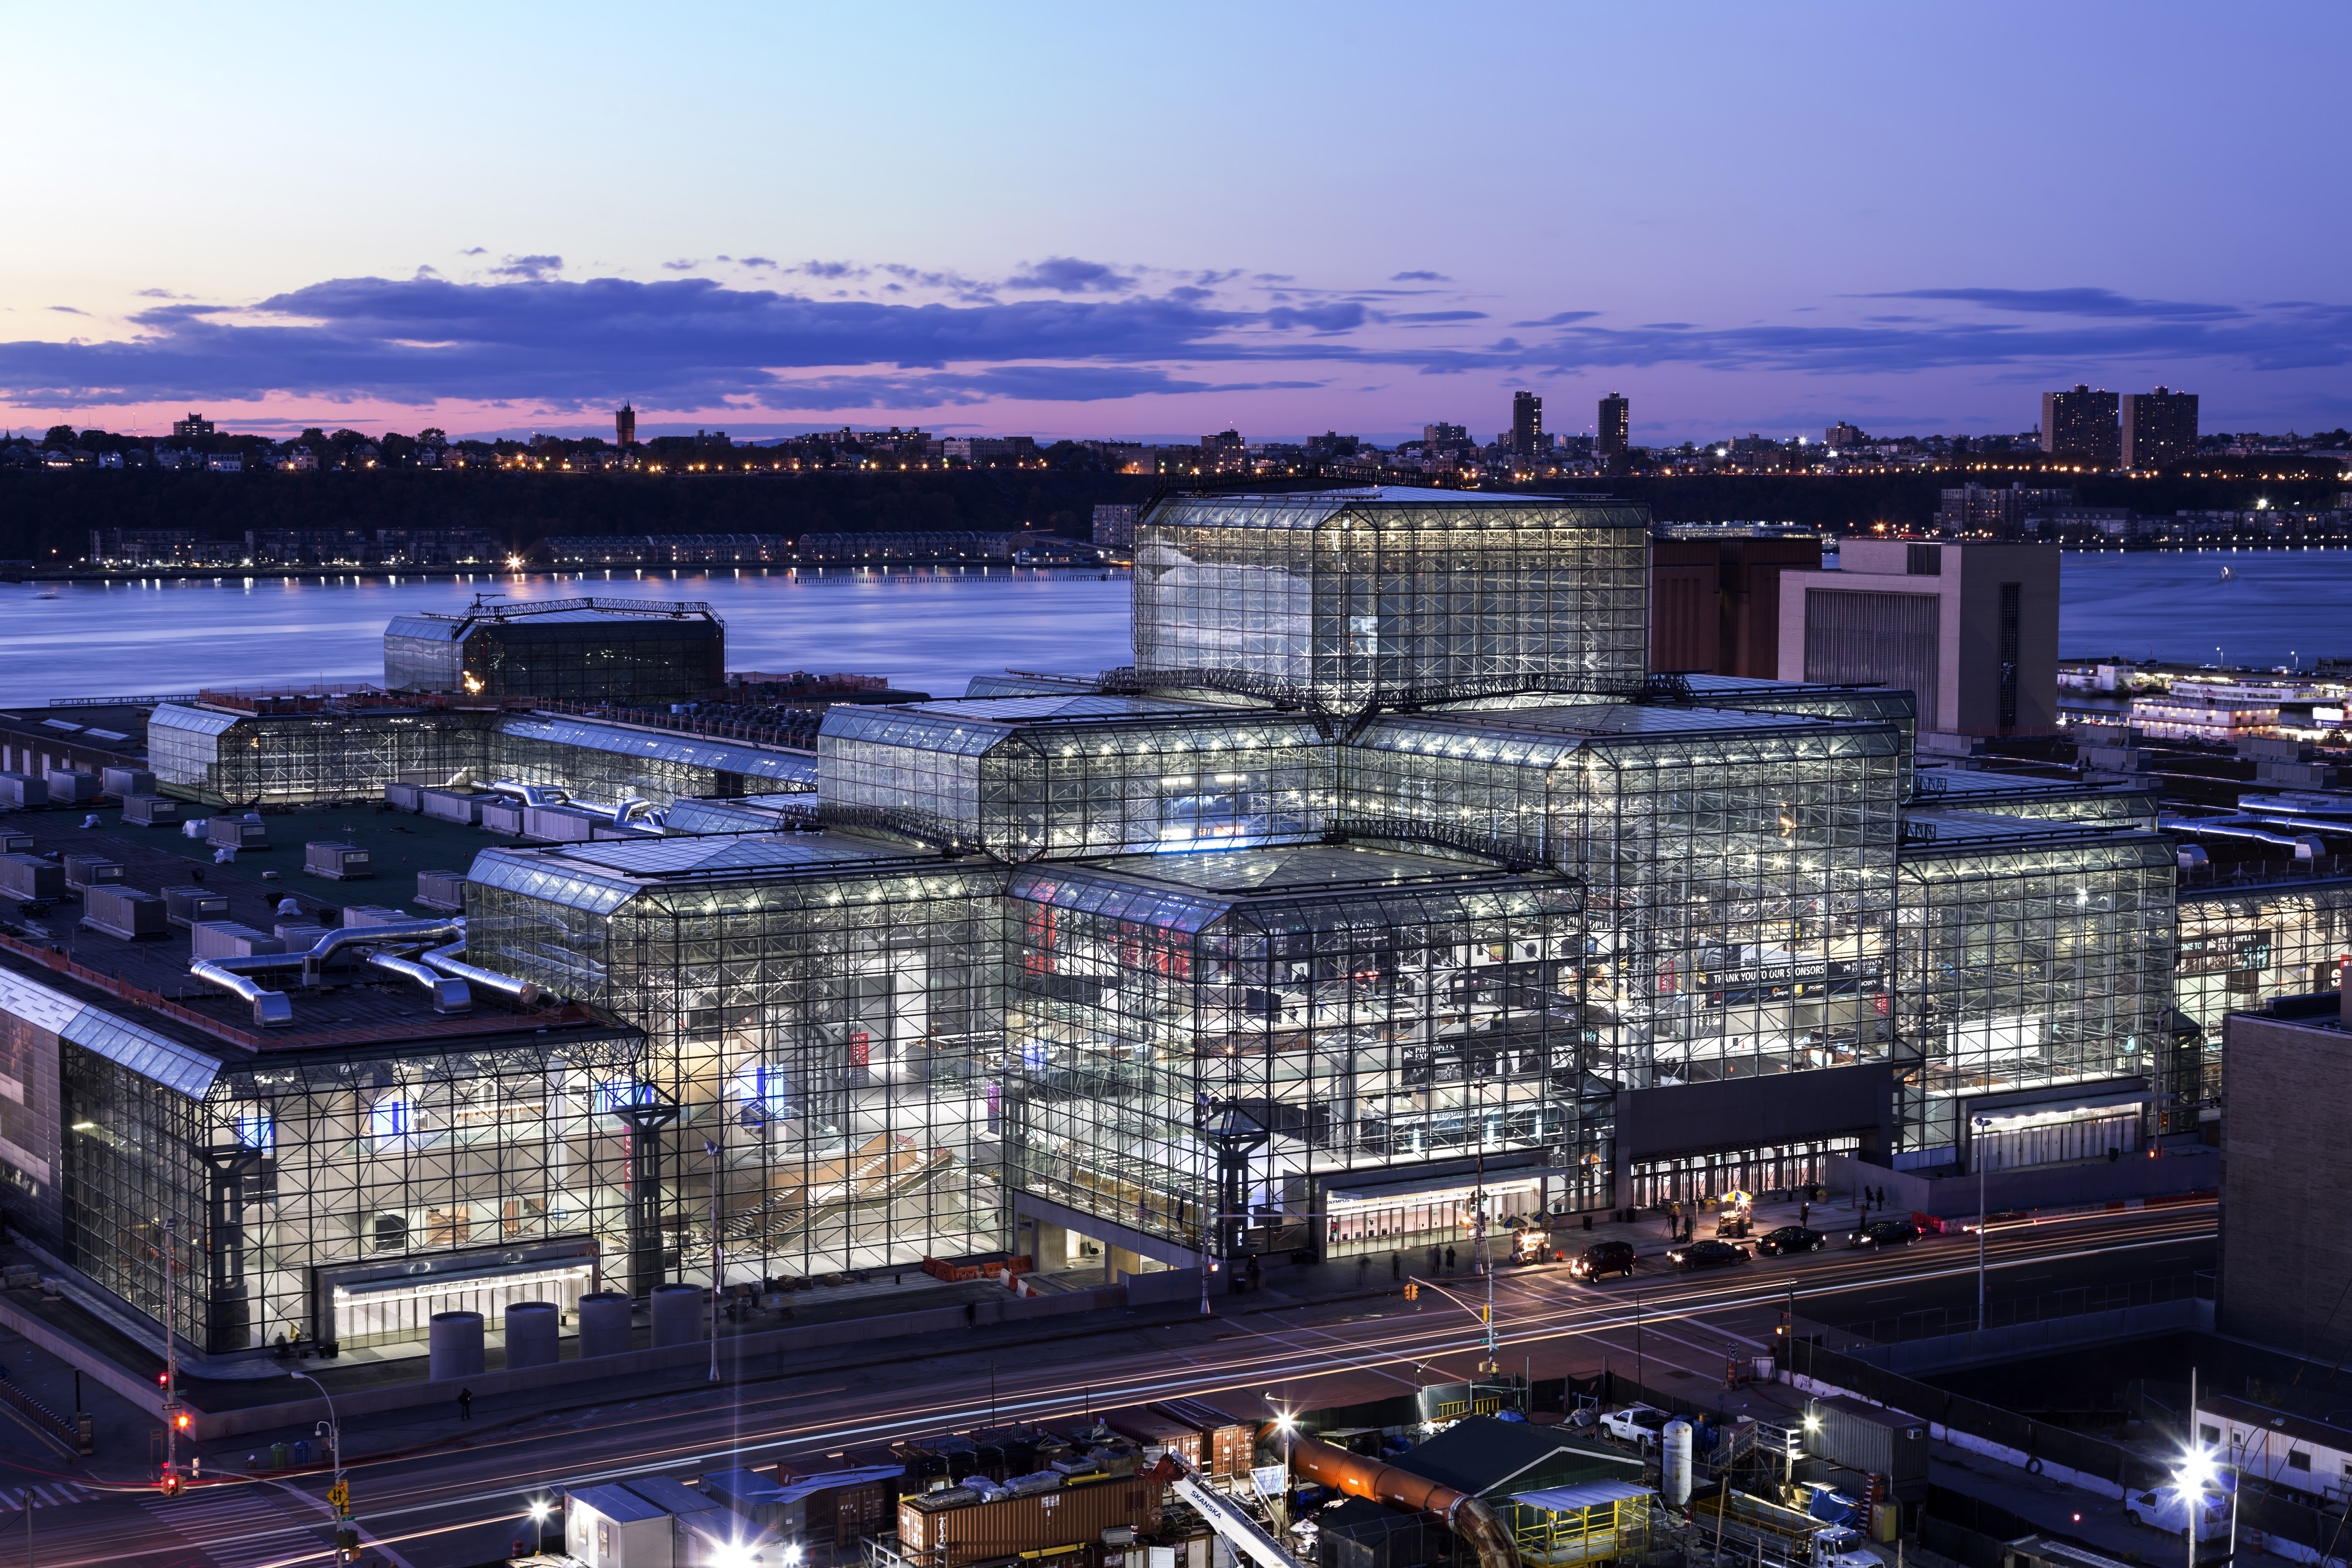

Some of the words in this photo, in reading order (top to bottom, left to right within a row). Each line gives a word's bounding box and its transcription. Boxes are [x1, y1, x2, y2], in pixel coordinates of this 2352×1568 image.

[1741, 972, 1755, 981] YOU
[1769, 969, 1785, 978] OUR
[1786, 965, 1825, 977] SONSORS
[1191, 1490, 1221, 1519] SKANSKA
